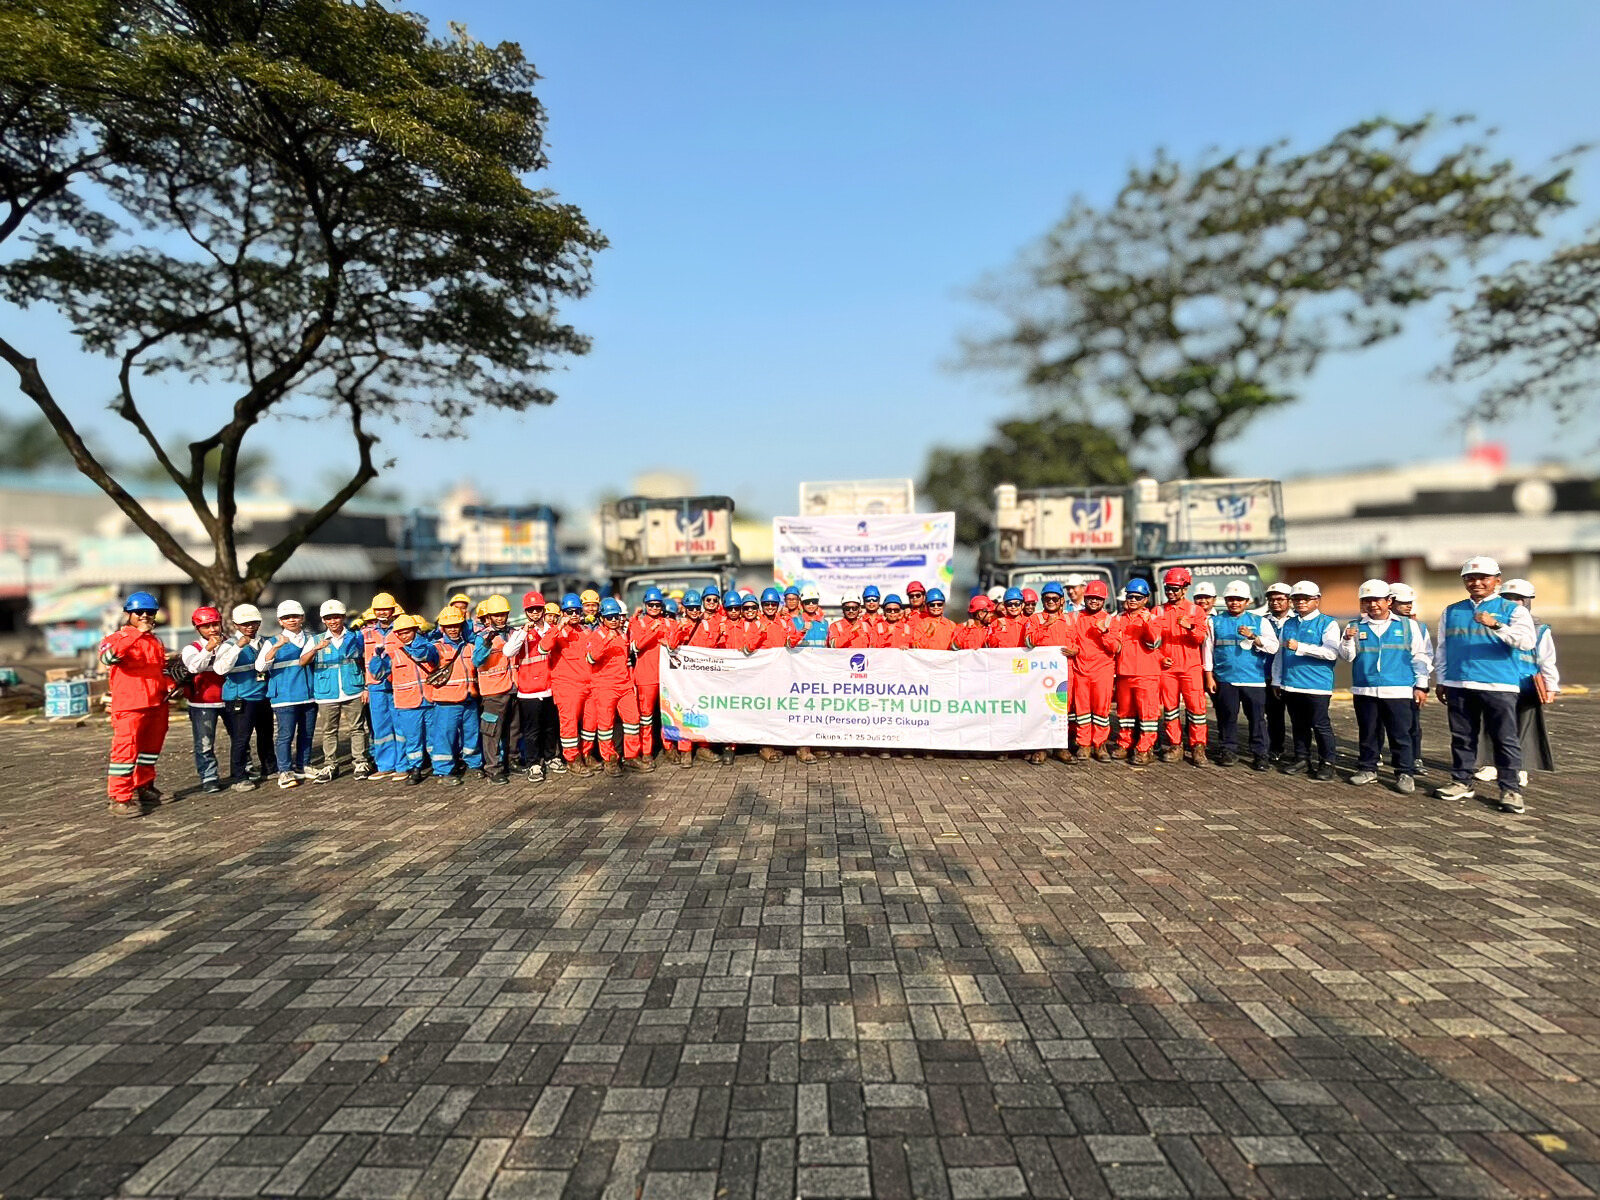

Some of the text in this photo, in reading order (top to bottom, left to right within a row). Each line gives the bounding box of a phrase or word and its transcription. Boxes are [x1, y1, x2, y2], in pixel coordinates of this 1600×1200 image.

[820, 545, 832, 553] KE
[835, 545, 842, 553] 4
[890, 543, 907, 552] UID
[1193, 565, 1248, 576] SERPONG
[682, 664, 722, 672] Indonesia
[1030, 661, 1058, 670] PLN
[790, 682, 929, 696] APEL PEMBUKAAN
[697, 695, 1027, 715] SINERGI KE 4 PDKB-TM UID BANTEN
[788, 715, 930, 728] PT PLN (Persero) UP3 Cikupa
